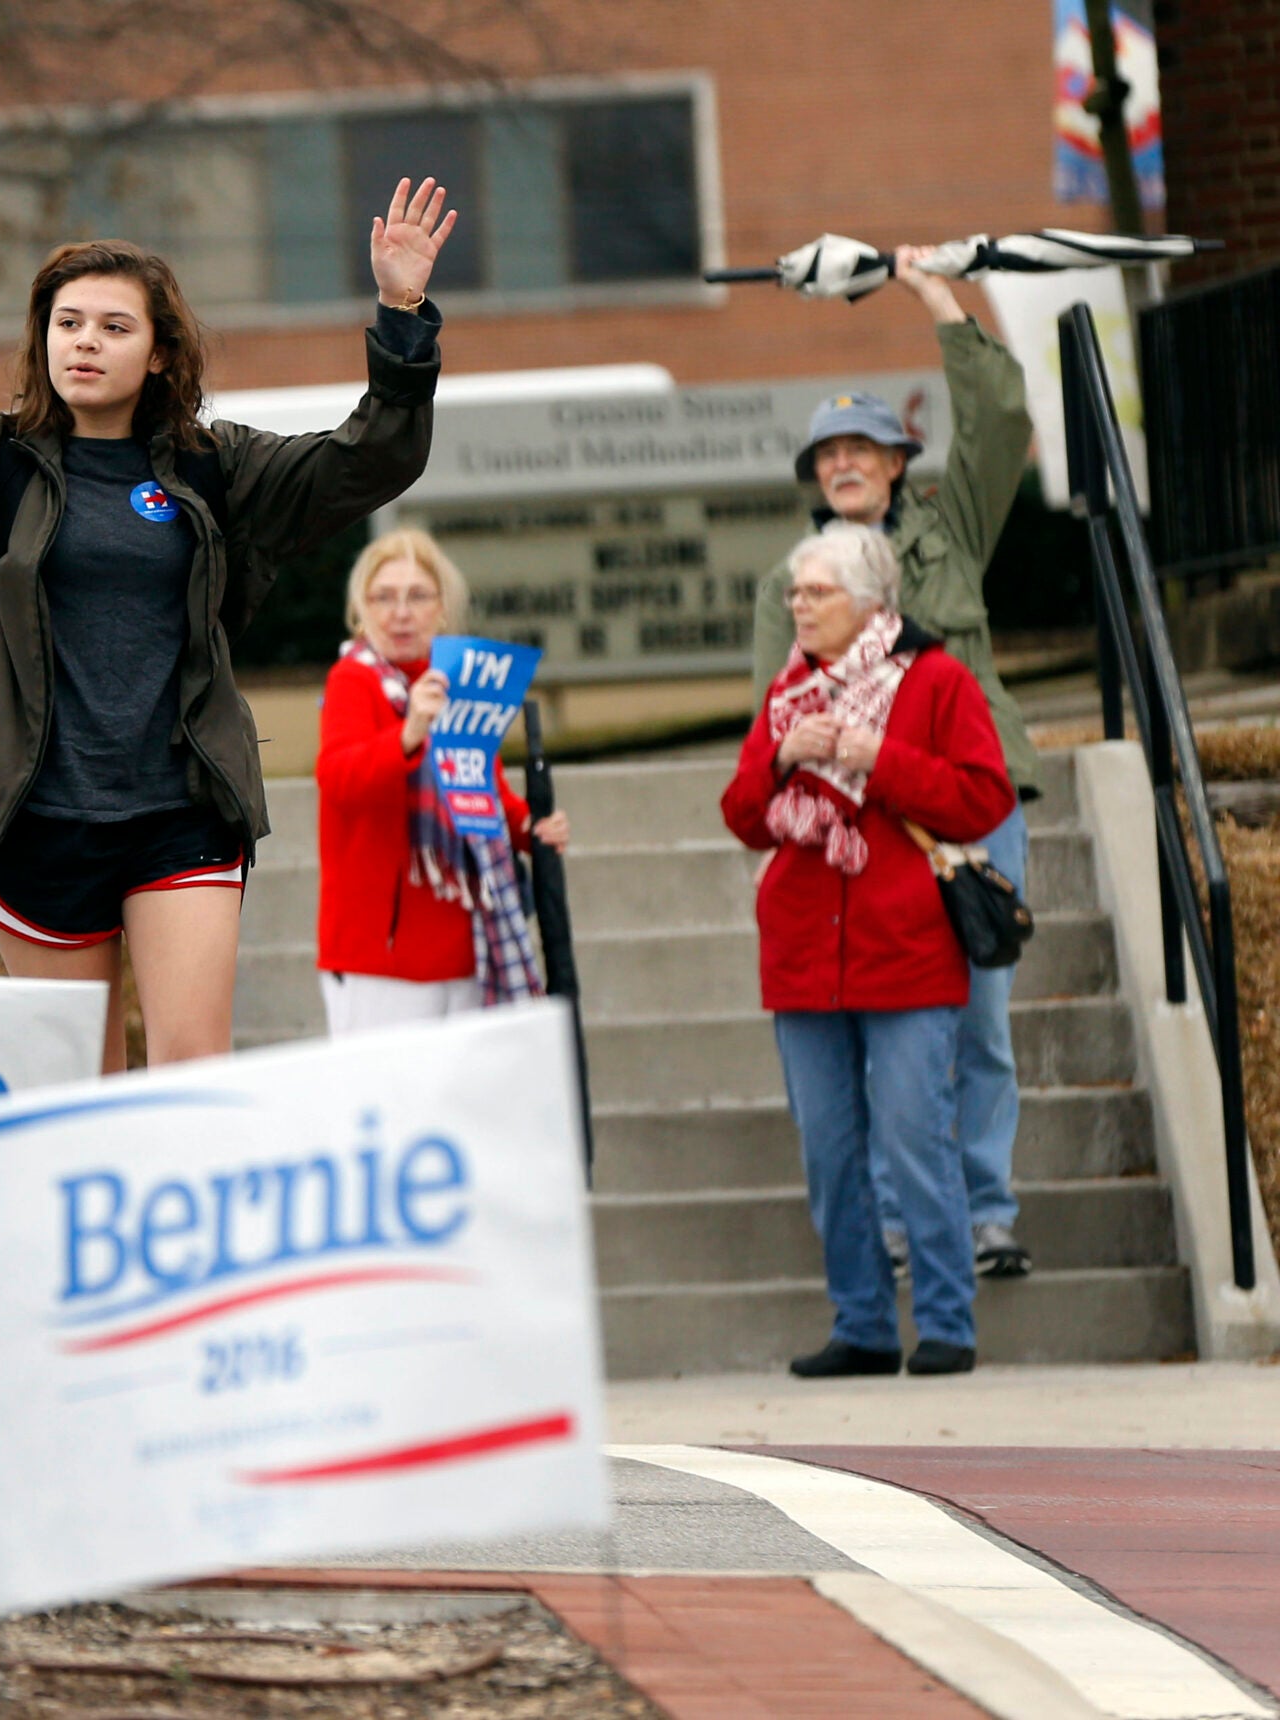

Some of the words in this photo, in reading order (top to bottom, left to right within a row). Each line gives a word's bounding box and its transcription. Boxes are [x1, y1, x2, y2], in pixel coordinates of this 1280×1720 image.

[460, 648, 513, 690] I'M
[435, 748, 486, 786] HER
[56, 1107, 469, 1302] Bernie
